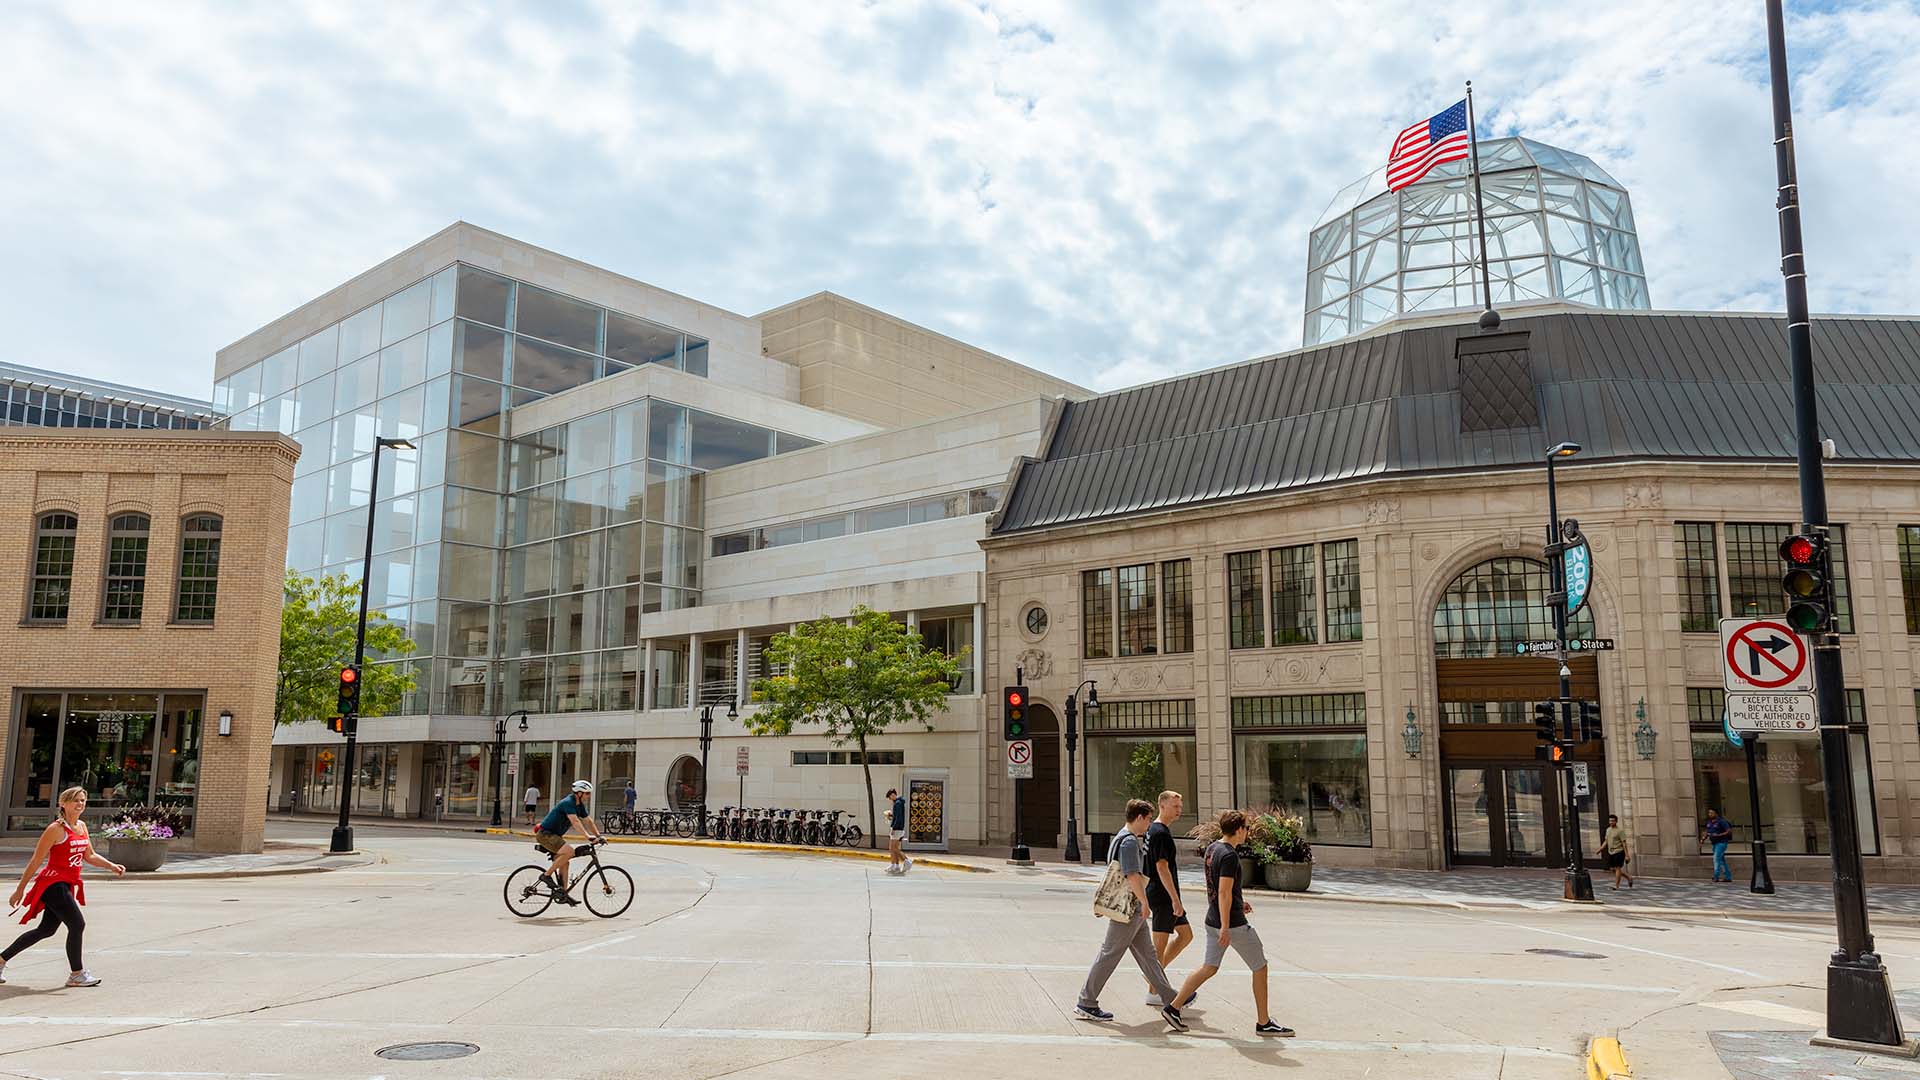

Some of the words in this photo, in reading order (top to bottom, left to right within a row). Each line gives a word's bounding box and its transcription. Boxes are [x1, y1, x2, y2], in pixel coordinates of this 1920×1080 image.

[1573, 544, 1585, 596] 200
[1566, 558, 1576, 598] BLOCK
[1529, 642, 1553, 651] Fairchild
[1582, 640, 1604, 649] State
[1734, 712, 1759, 720] POLICE
[1575, 766, 1585, 774] ONE
